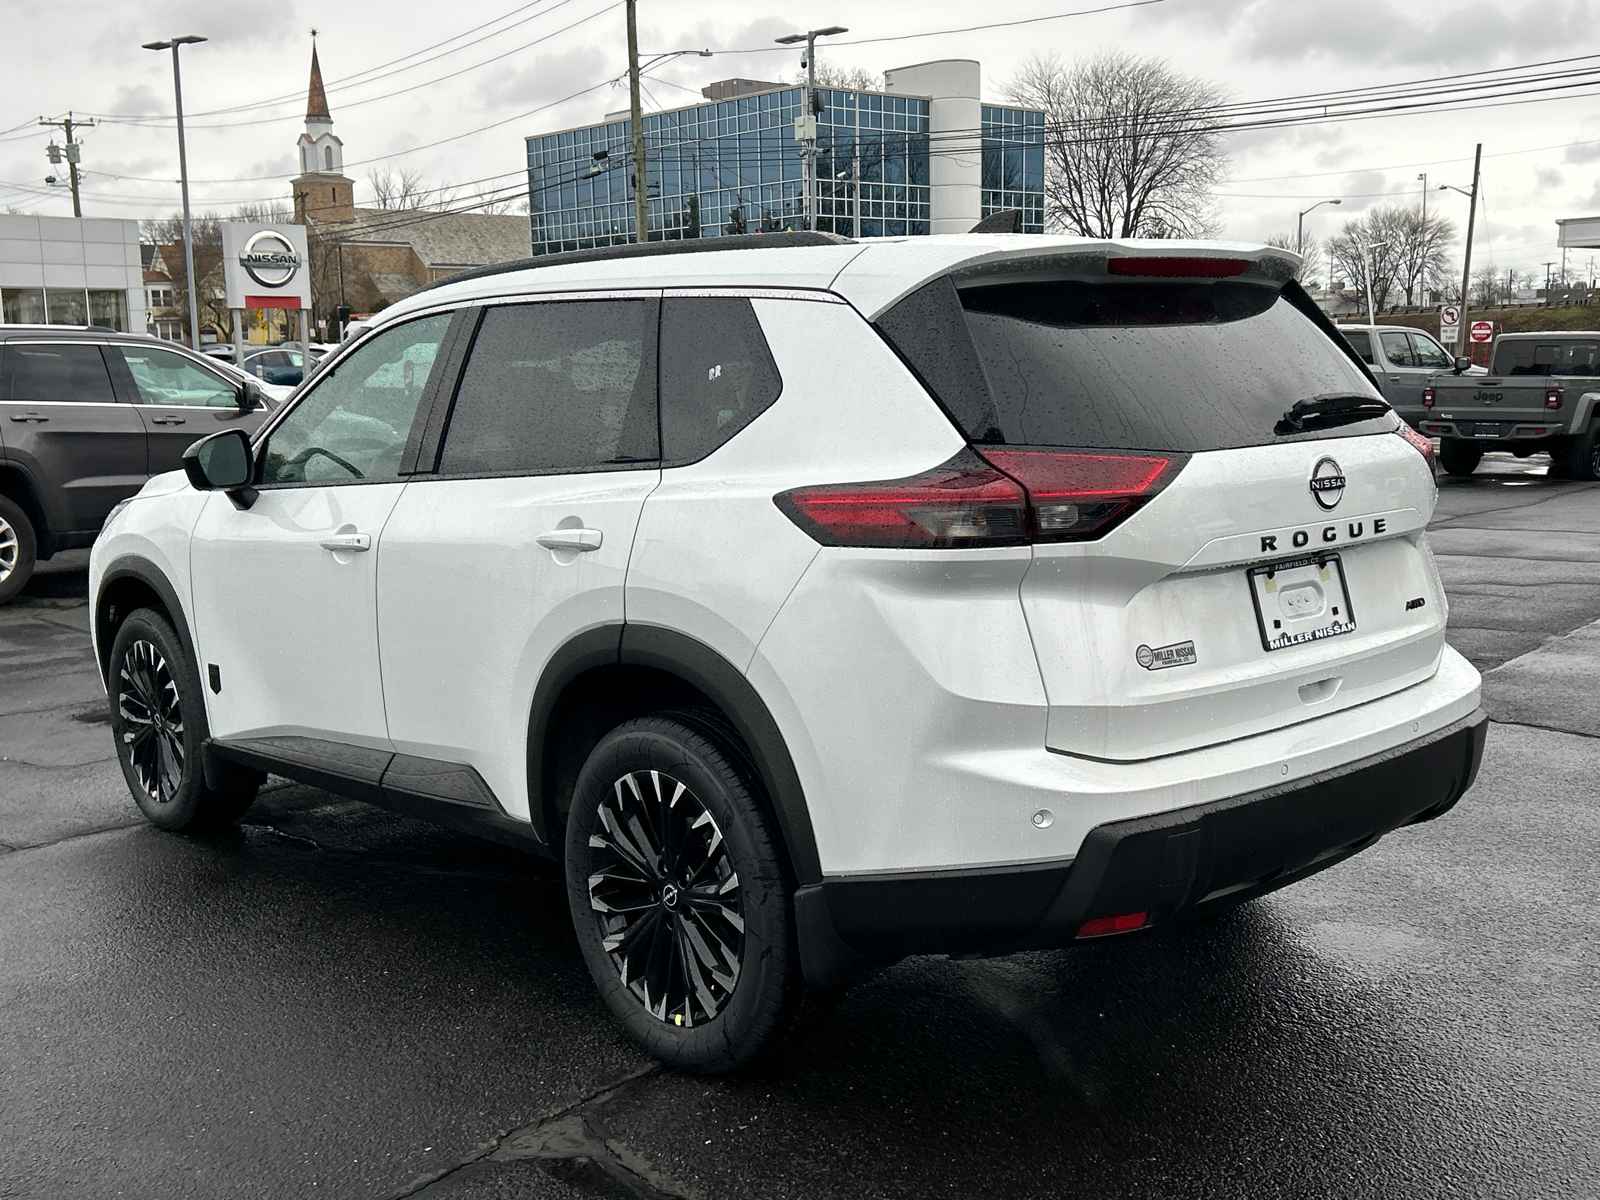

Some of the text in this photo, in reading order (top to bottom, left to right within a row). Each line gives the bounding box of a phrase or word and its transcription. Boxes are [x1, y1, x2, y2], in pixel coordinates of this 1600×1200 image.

[247, 254, 297, 264] NISSAN
[1473, 390, 1504, 402] Jeep
[1311, 478, 1346, 490] NISSAN
[1260, 518, 1386, 552] ROGUE
[1269, 622, 1356, 650] MILLER NISSAN
[1154, 650, 1174, 662] MILLER
[1174, 646, 1195, 658] NISSAN
